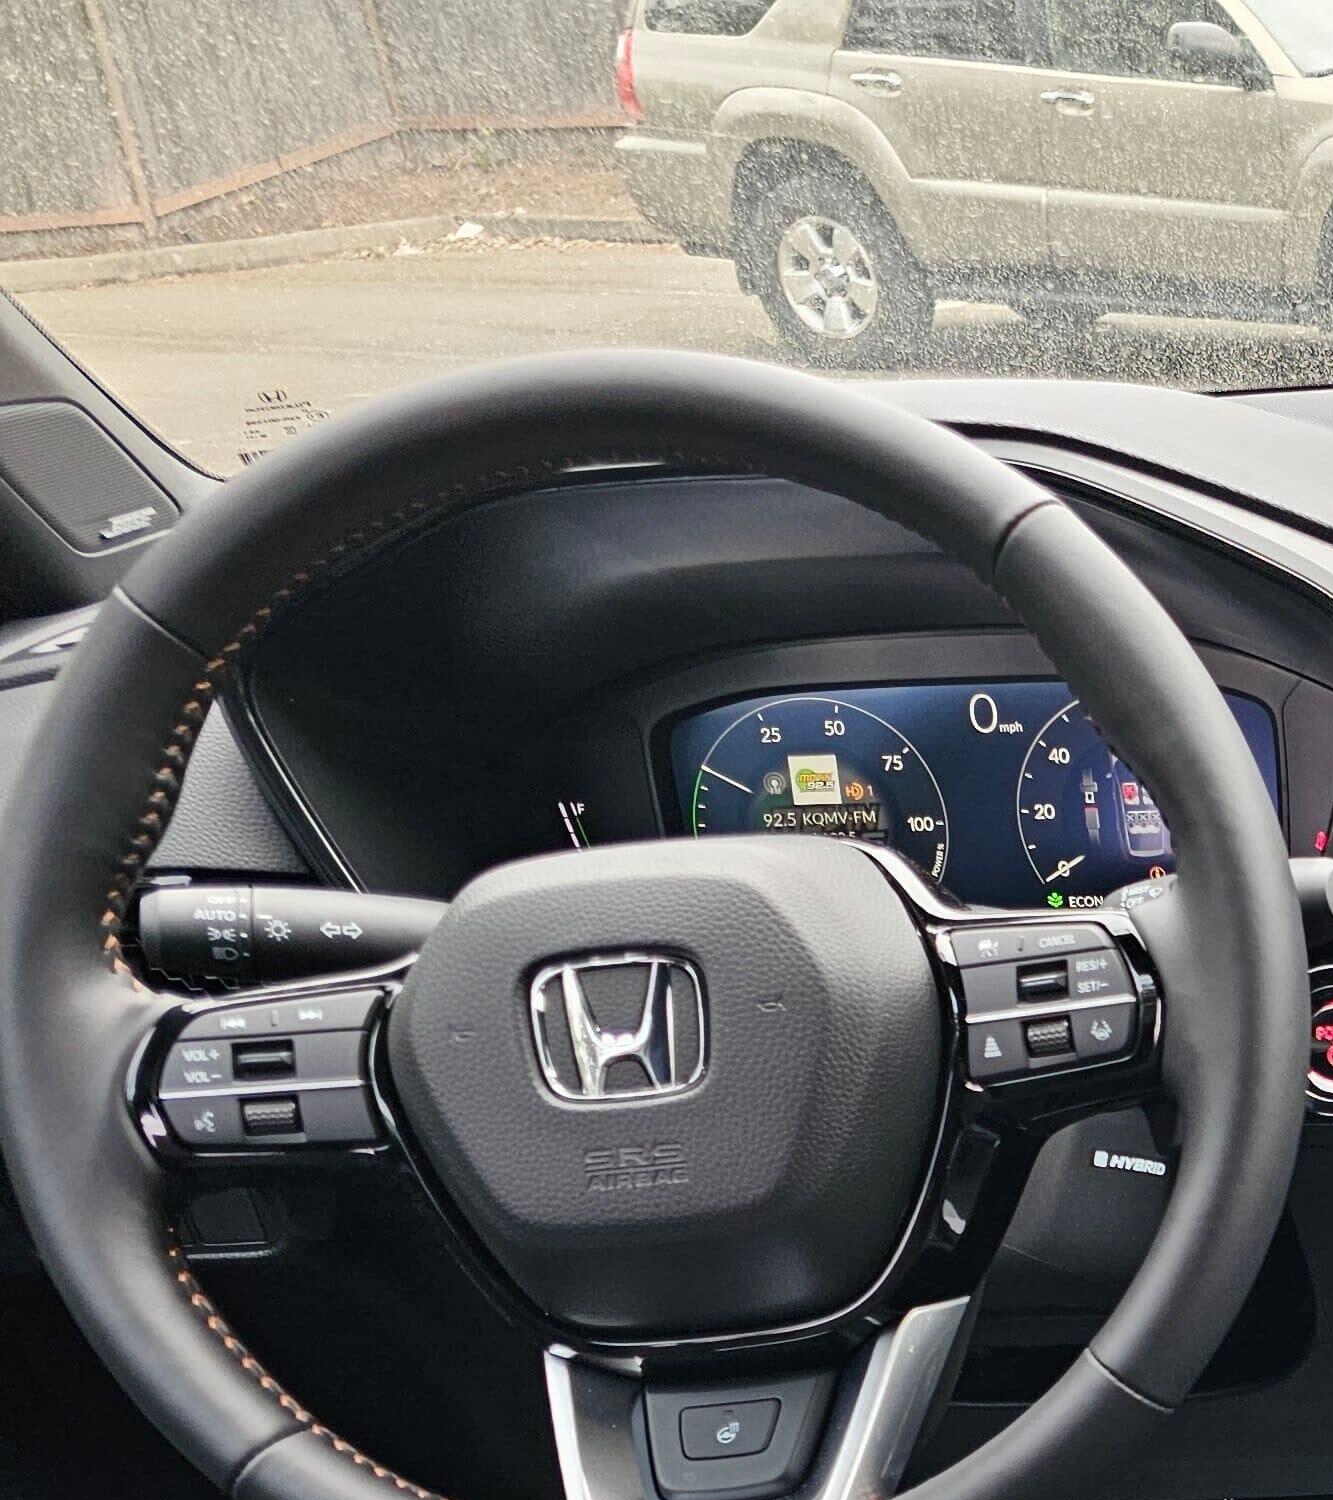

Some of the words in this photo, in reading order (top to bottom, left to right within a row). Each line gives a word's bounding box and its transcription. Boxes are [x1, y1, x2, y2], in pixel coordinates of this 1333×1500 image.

[969, 693, 998, 734] 0
[998, 722, 1024, 736] mph
[760, 728, 782, 743] 25
[824, 721, 846, 736] 50
[881, 755, 904, 772] 75
[1048, 748, 1070, 765] 40
[576, 802, 585, 815] F
[1034, 804, 1056, 820] 20
[763, 812, 797, 828] 92.5
[802, 810, 877, 827] KQMV-FM
[907, 816, 935, 832] 100
[931, 851, 944, 878] POWER
[1068, 895, 1104, 908] ECON
[193, 909, 236, 922] AUTO
[1039, 934, 1077, 949] CANCEL
[584, 1144, 685, 1167] SRS
[1110, 1154, 1166, 1176] HYBRID
